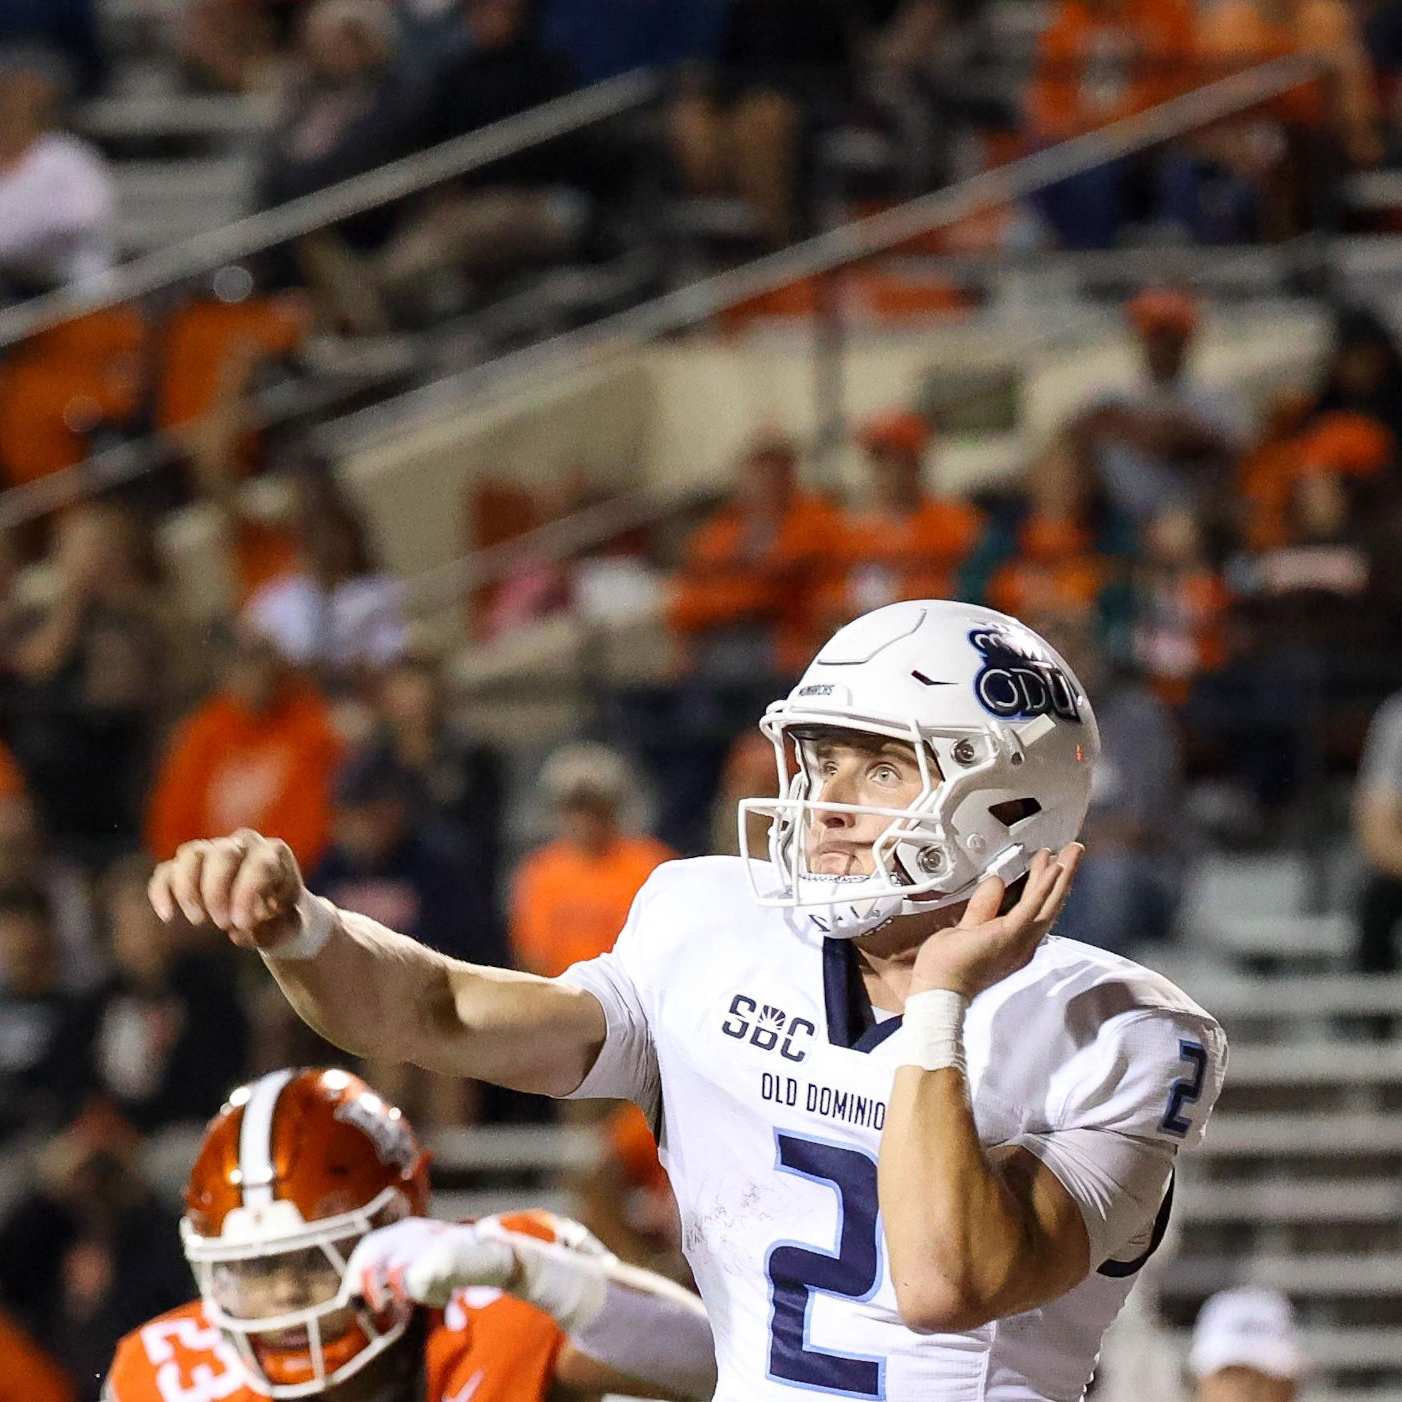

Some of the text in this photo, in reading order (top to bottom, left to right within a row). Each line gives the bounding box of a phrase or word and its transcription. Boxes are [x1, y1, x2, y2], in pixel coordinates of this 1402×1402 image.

[976, 664, 1081, 722] ODU
[722, 994, 815, 1062] SBC
[761, 1072, 886, 1131] OLD DOMINIO
[1156, 1039, 1208, 1139] 2
